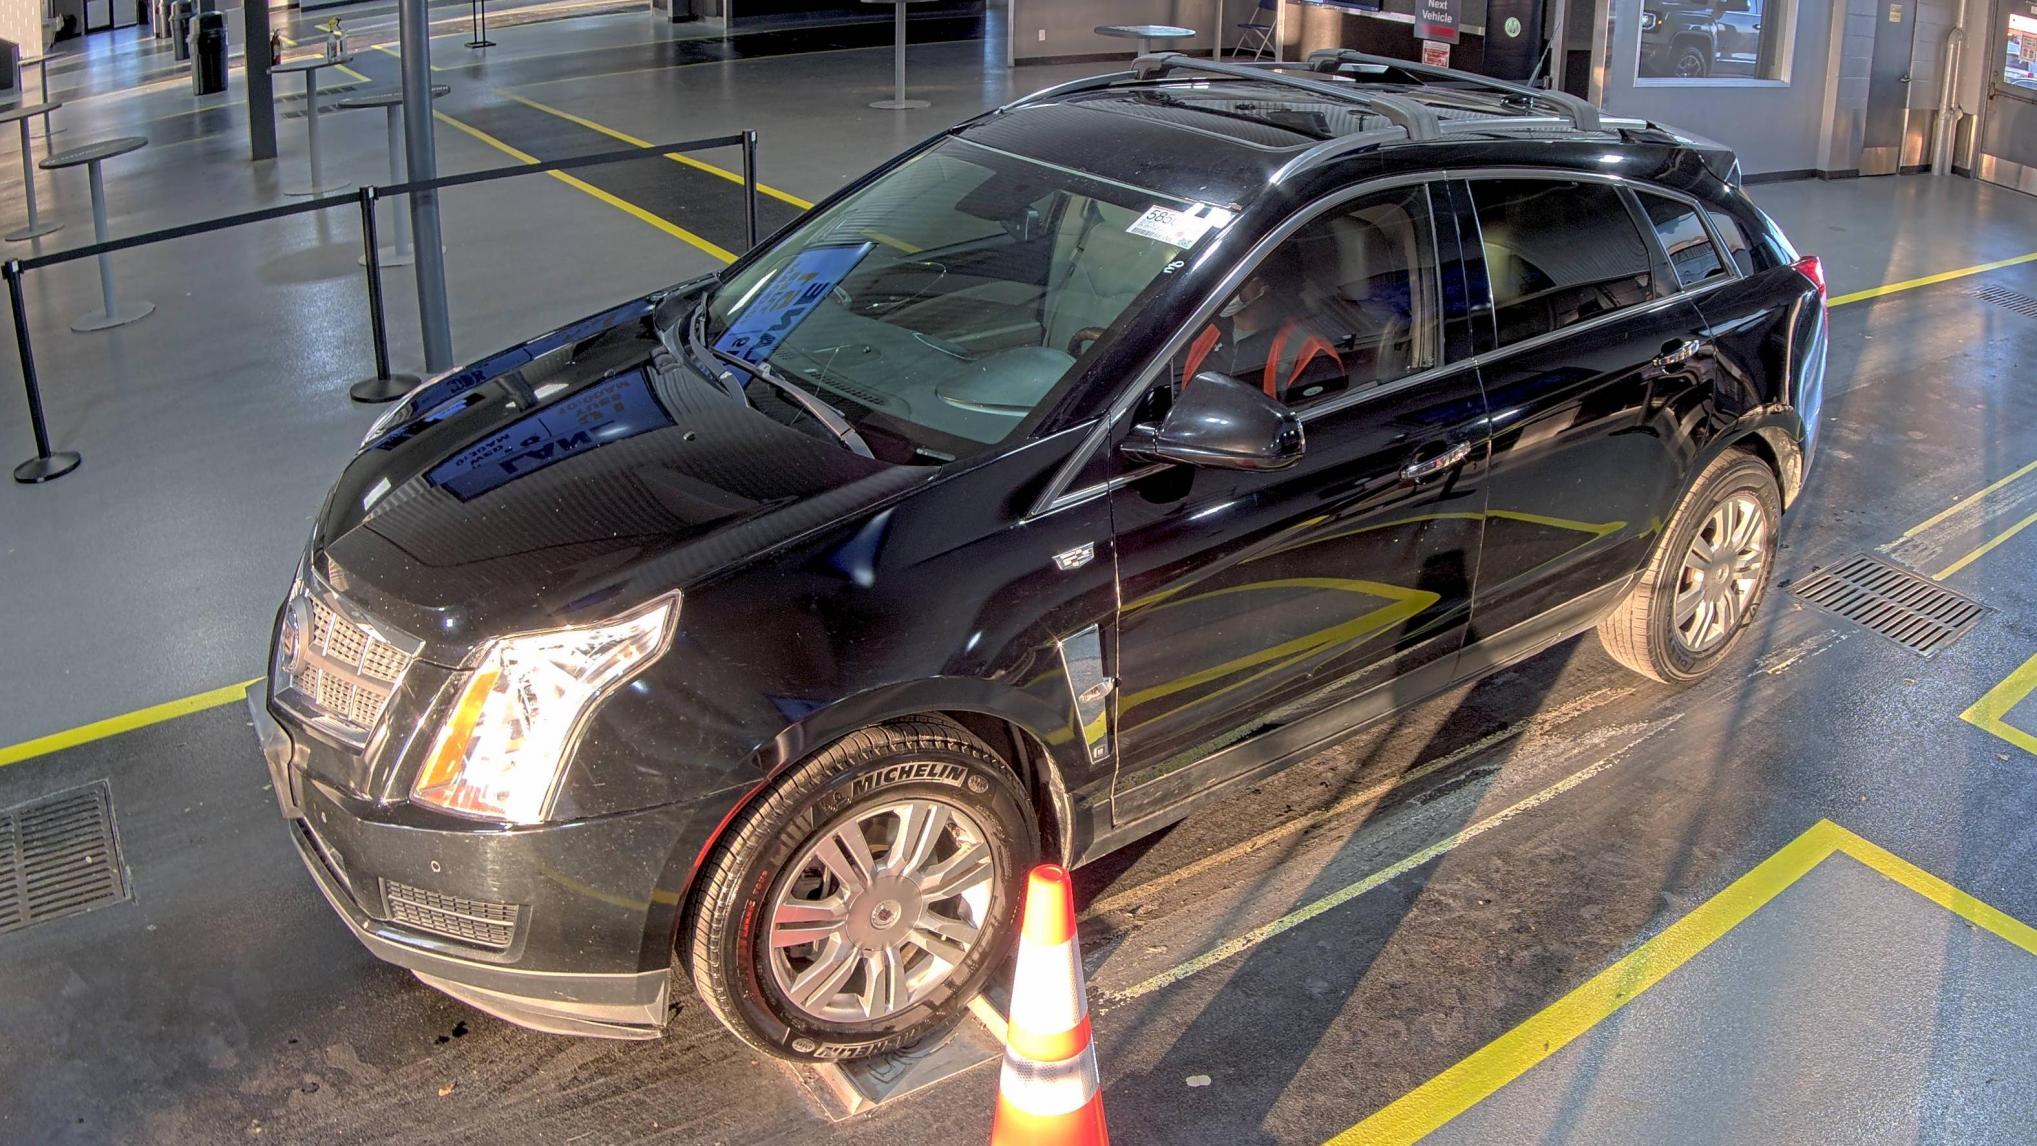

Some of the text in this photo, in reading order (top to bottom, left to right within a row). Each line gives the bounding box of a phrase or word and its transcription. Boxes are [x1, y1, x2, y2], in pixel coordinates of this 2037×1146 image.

[1428, 0, 1448, 10] Next
[1422, 9, 1453, 23] Vehicle
[852, 764, 966, 797] MICHELIN
